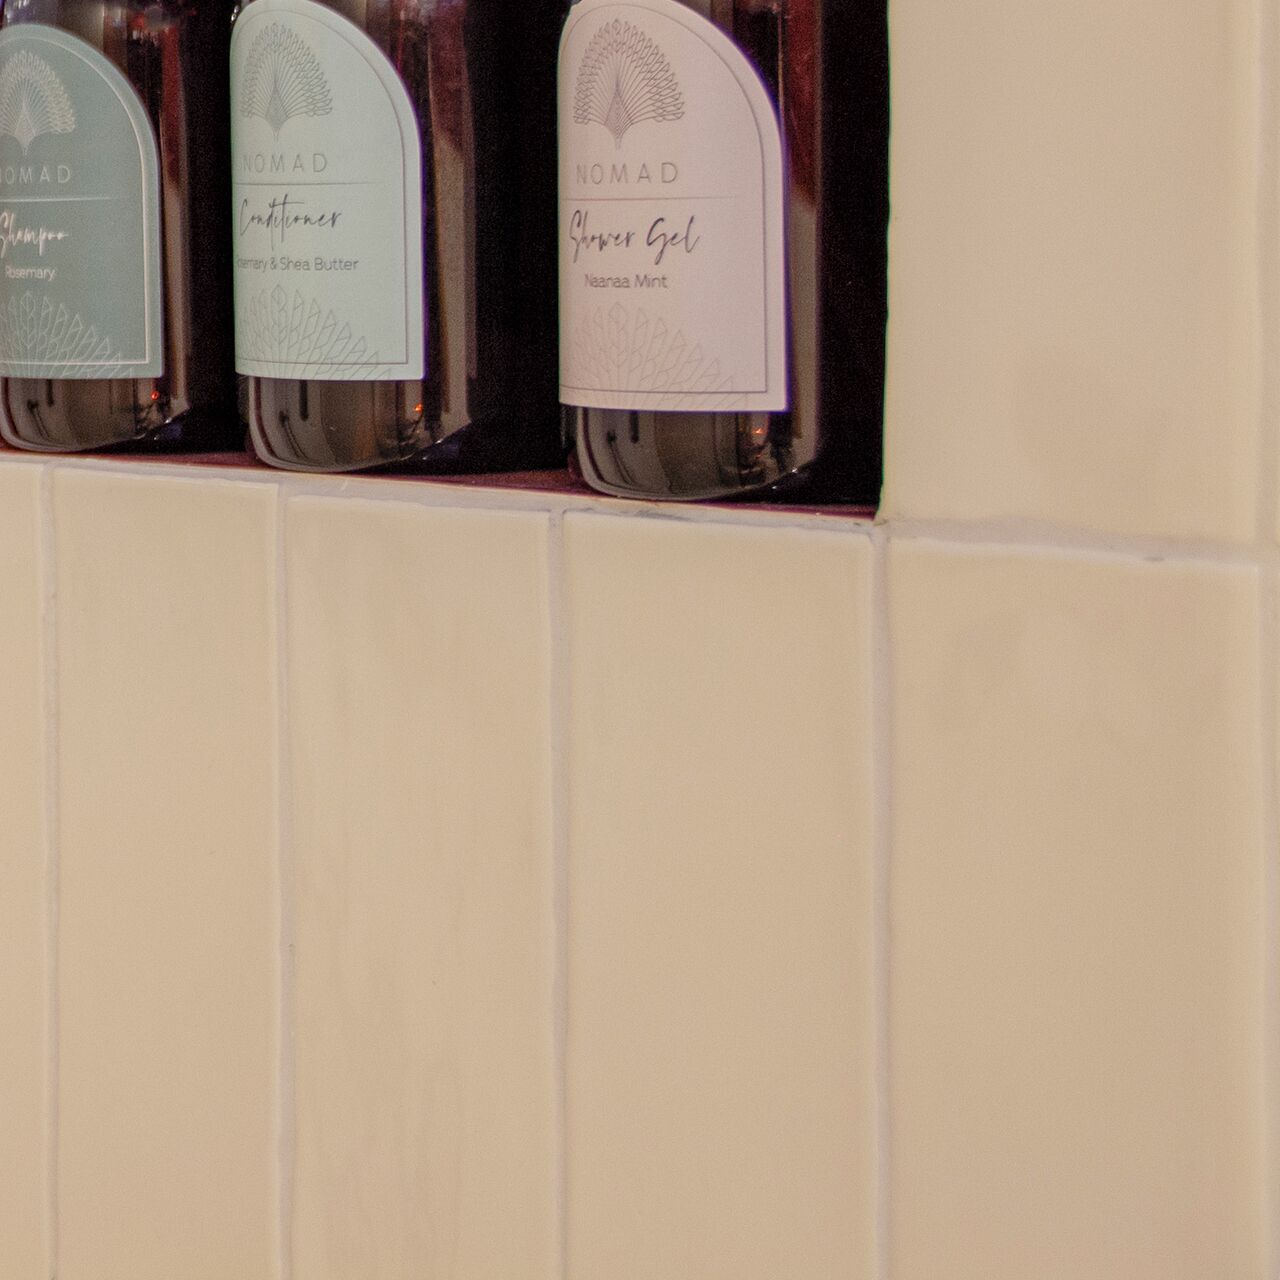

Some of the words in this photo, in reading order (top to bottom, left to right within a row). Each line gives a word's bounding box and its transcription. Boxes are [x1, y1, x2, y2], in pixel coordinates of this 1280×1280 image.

[242, 153, 328, 173] NOMAD
[576, 162, 679, 185] NOMAD
[569, 209, 636, 263] Shower
[646, 214, 700, 266] Gel
[5, 264, 56, 282] Rosemary
[279, 256, 310, 271] Shea
[313, 257, 359, 271] Butter
[634, 274, 669, 289] Mint
